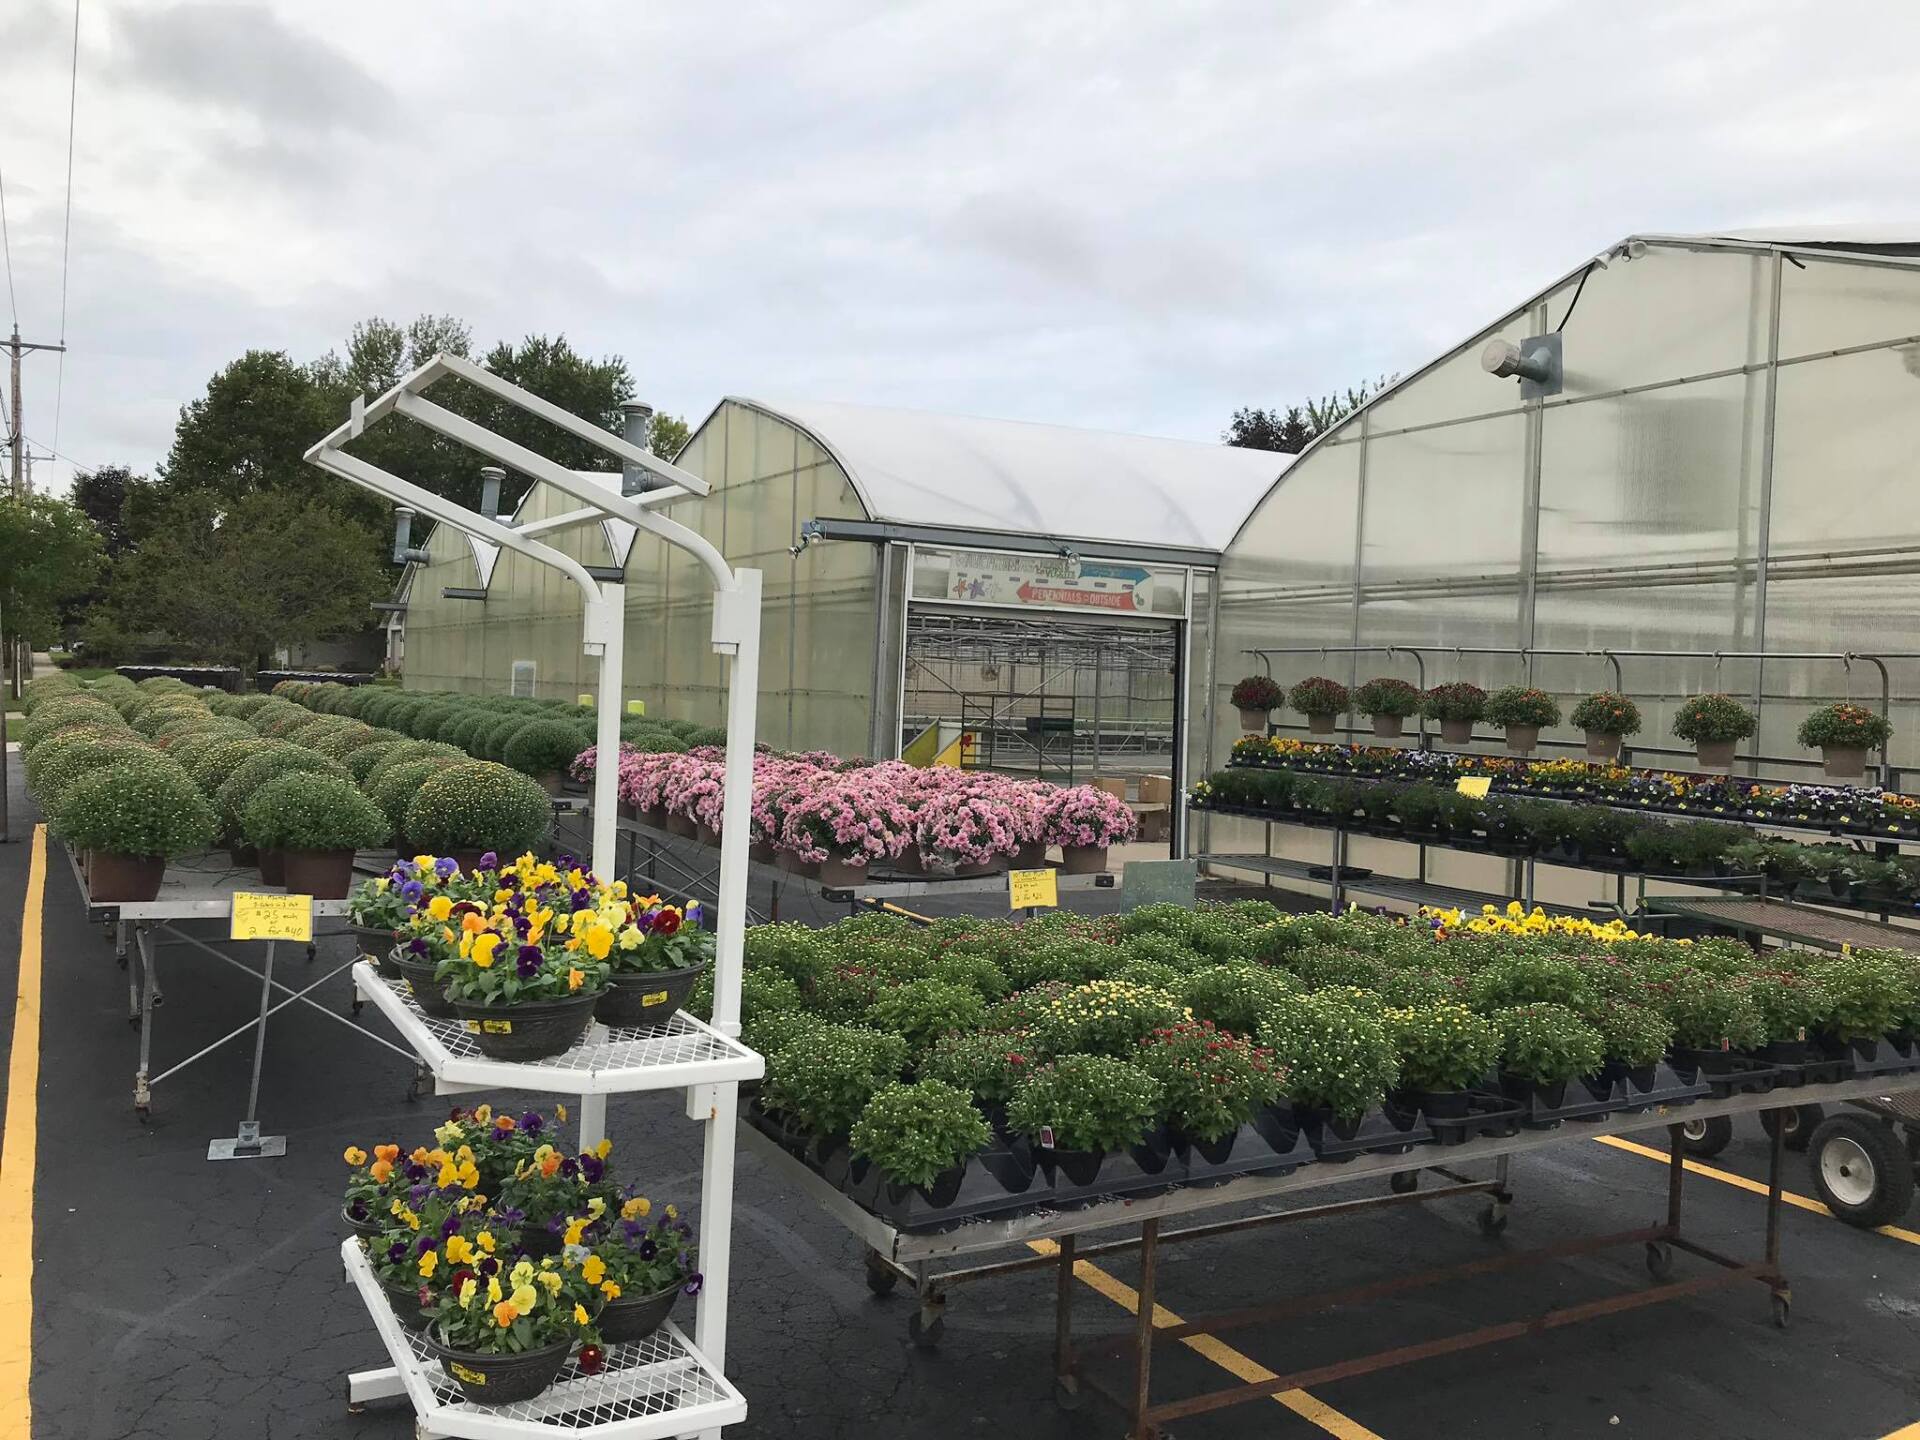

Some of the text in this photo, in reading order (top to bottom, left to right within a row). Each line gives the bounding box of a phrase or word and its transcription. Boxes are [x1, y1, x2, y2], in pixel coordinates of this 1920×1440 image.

[1031, 588, 1121, 606] PERENNIALS OUTSIDE
[256, 910, 279, 920] $25
[248, 925, 304, 937] 2 for $40
